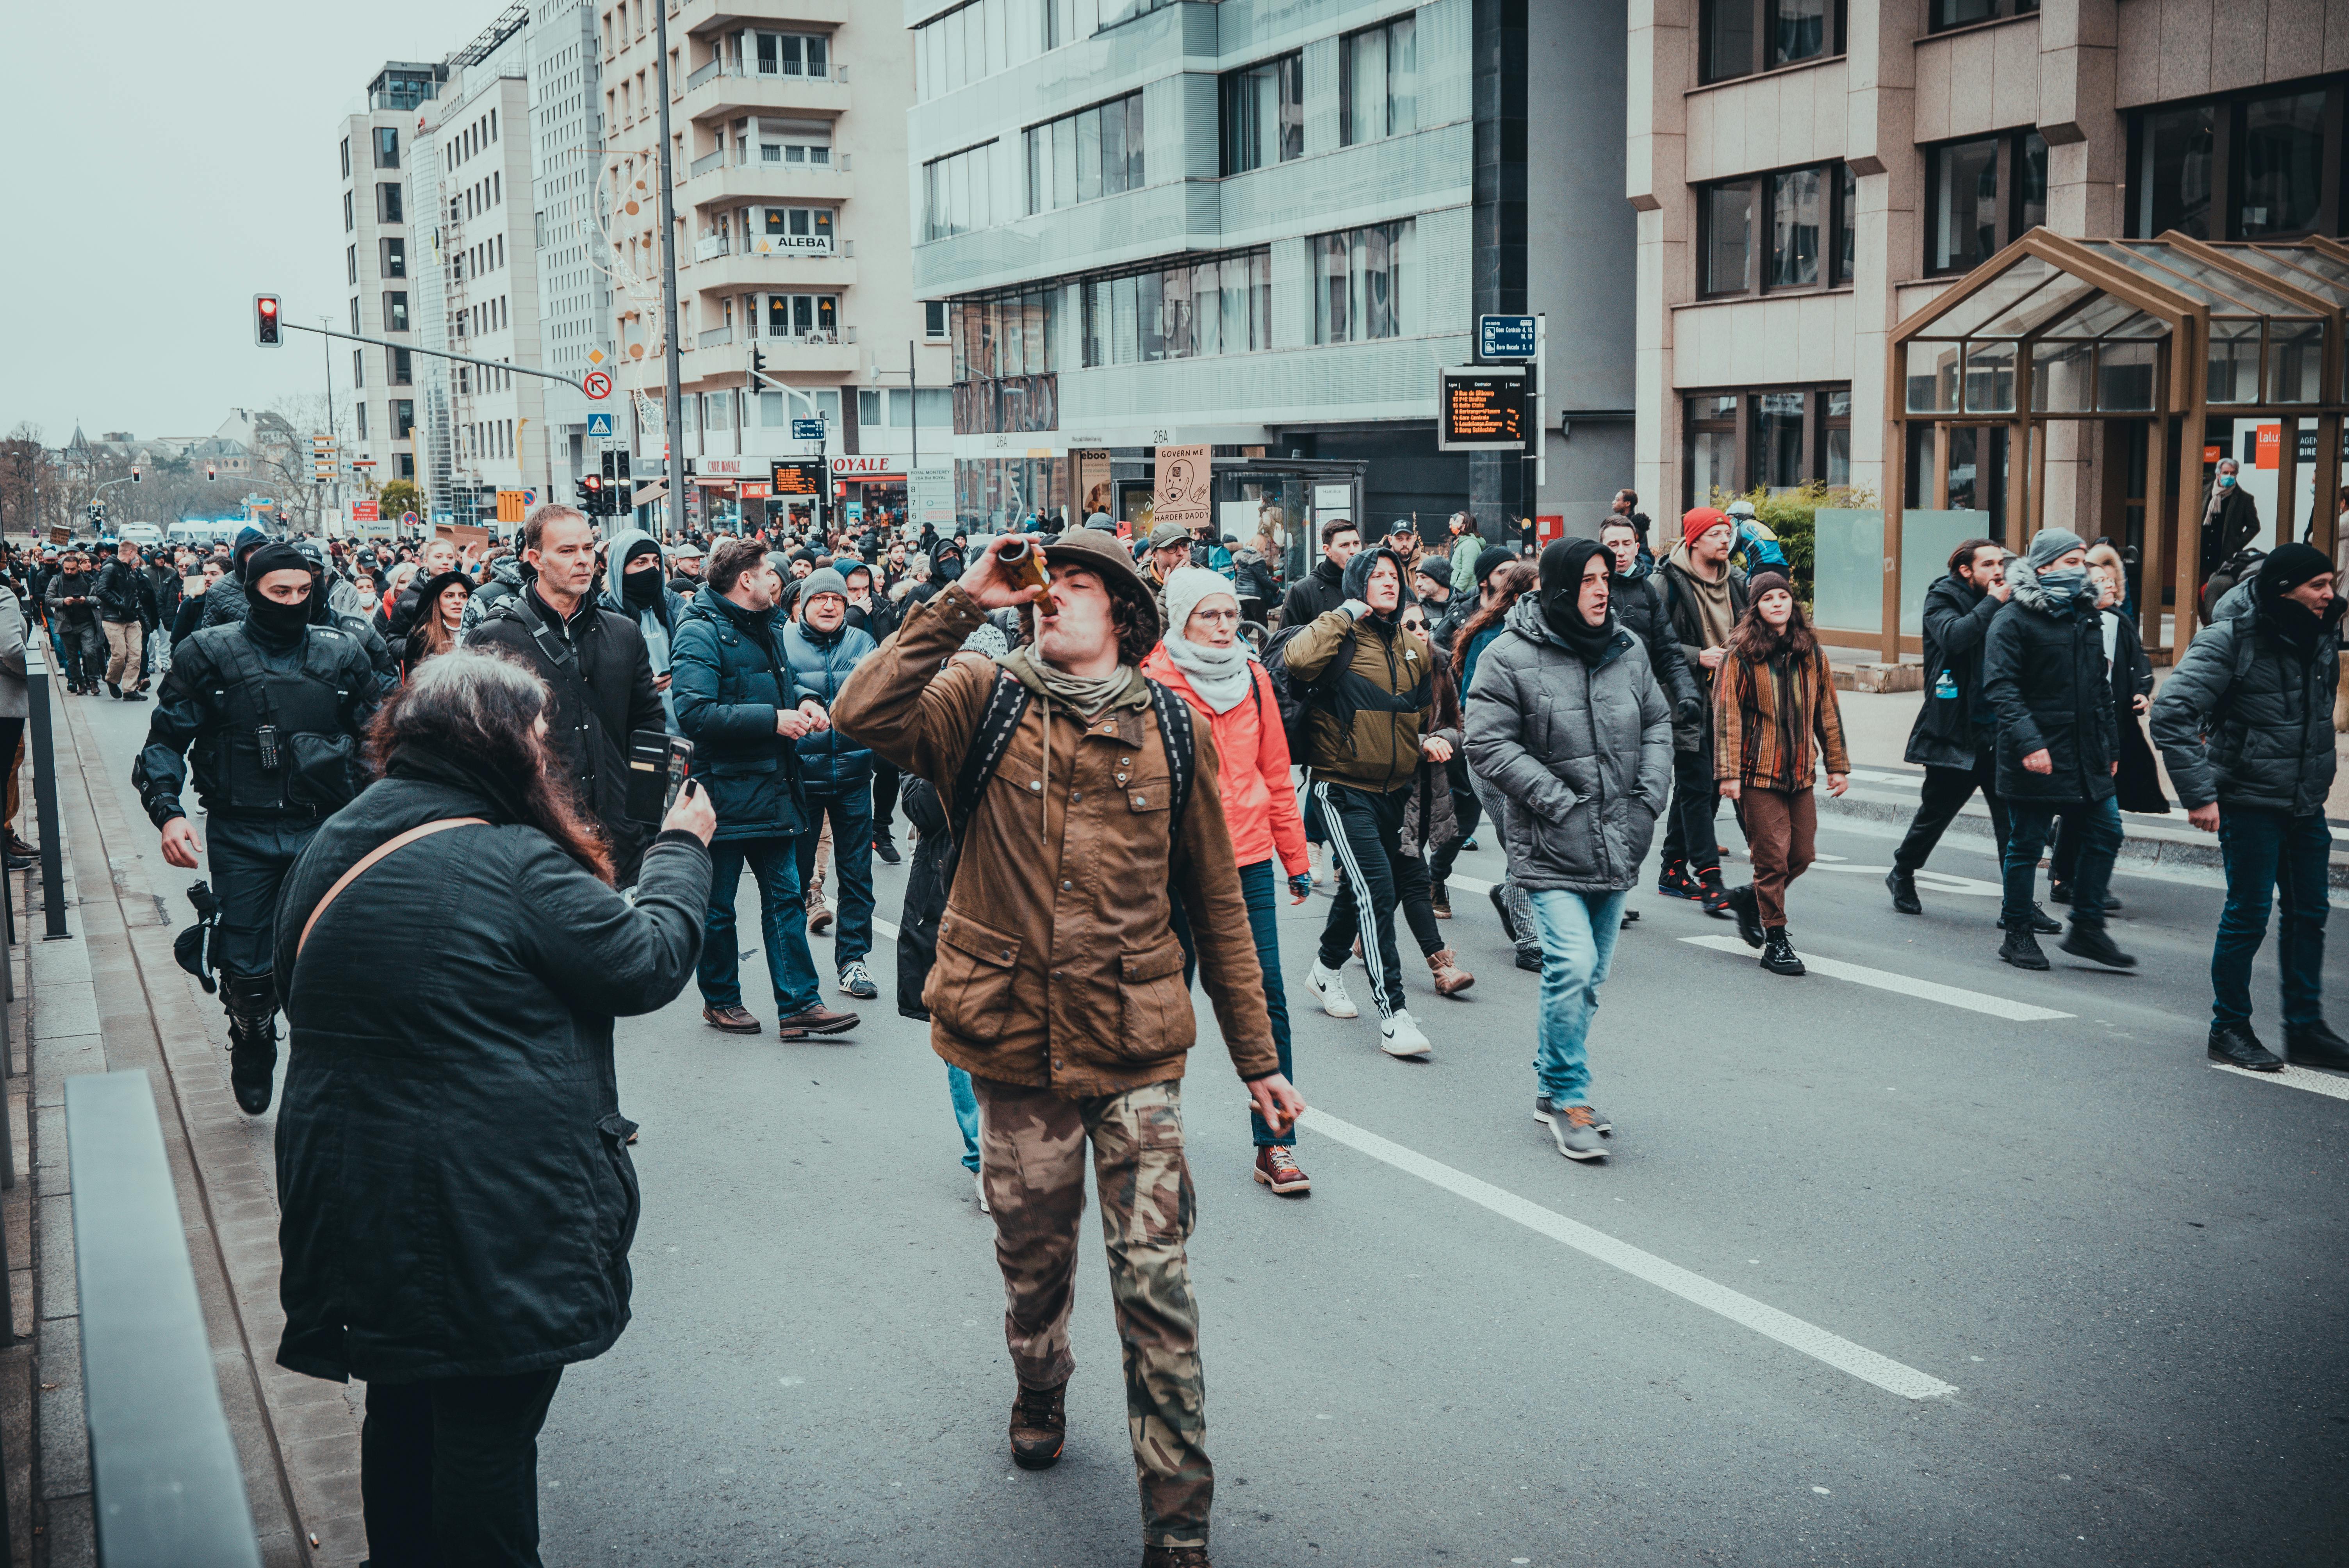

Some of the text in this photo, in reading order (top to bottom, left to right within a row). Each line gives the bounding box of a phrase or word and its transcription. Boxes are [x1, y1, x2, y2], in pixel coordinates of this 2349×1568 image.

[778, 237, 826, 247] ALEBA
[996, 436, 1007, 447] 26A
[1154, 430, 1168, 444] 26A
[708, 460, 741, 473] CAVE ROYALE
[834, 458, 889, 471] OYALE
[1155, 511, 1209, 522] HARDER DADDY
